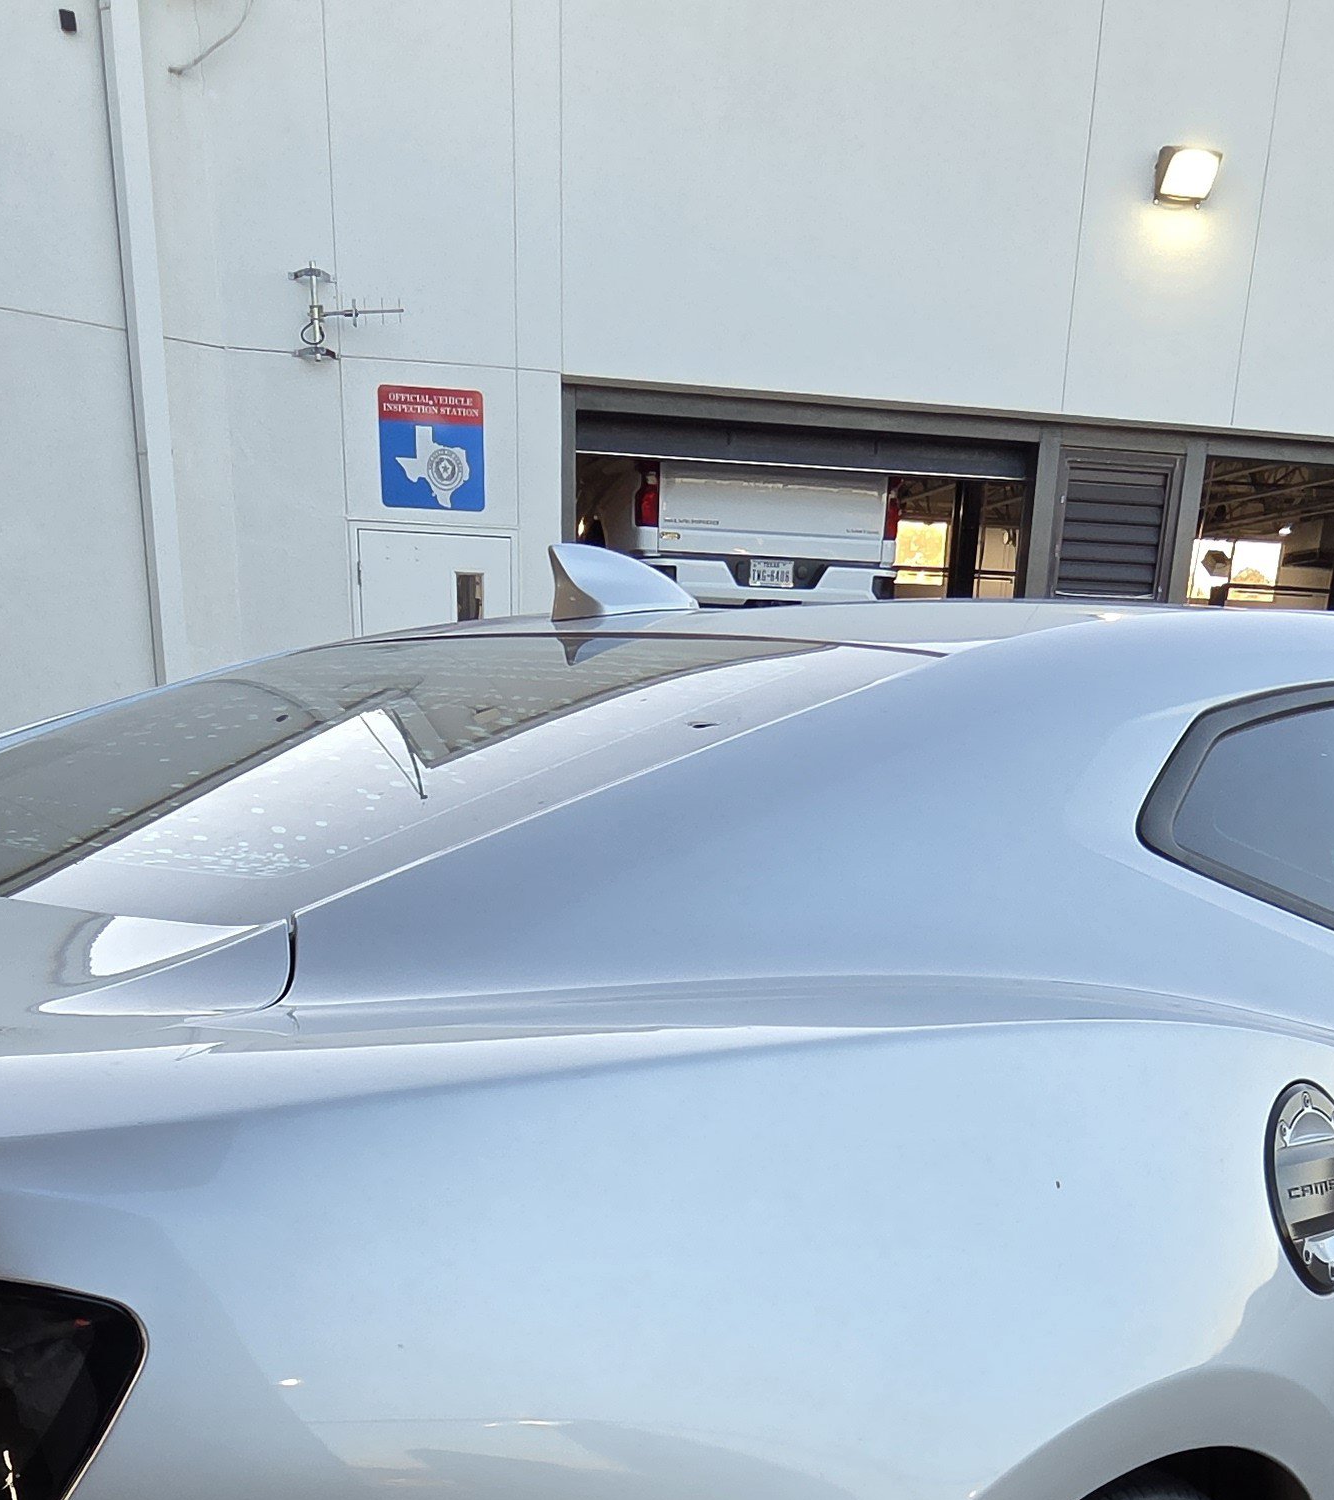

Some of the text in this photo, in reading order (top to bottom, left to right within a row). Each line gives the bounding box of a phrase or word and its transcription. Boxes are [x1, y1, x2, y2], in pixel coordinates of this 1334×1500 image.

[389, 393, 472, 406] OFFICIAL VEHICLE
[383, 403, 479, 417] INSPECTION STATION
